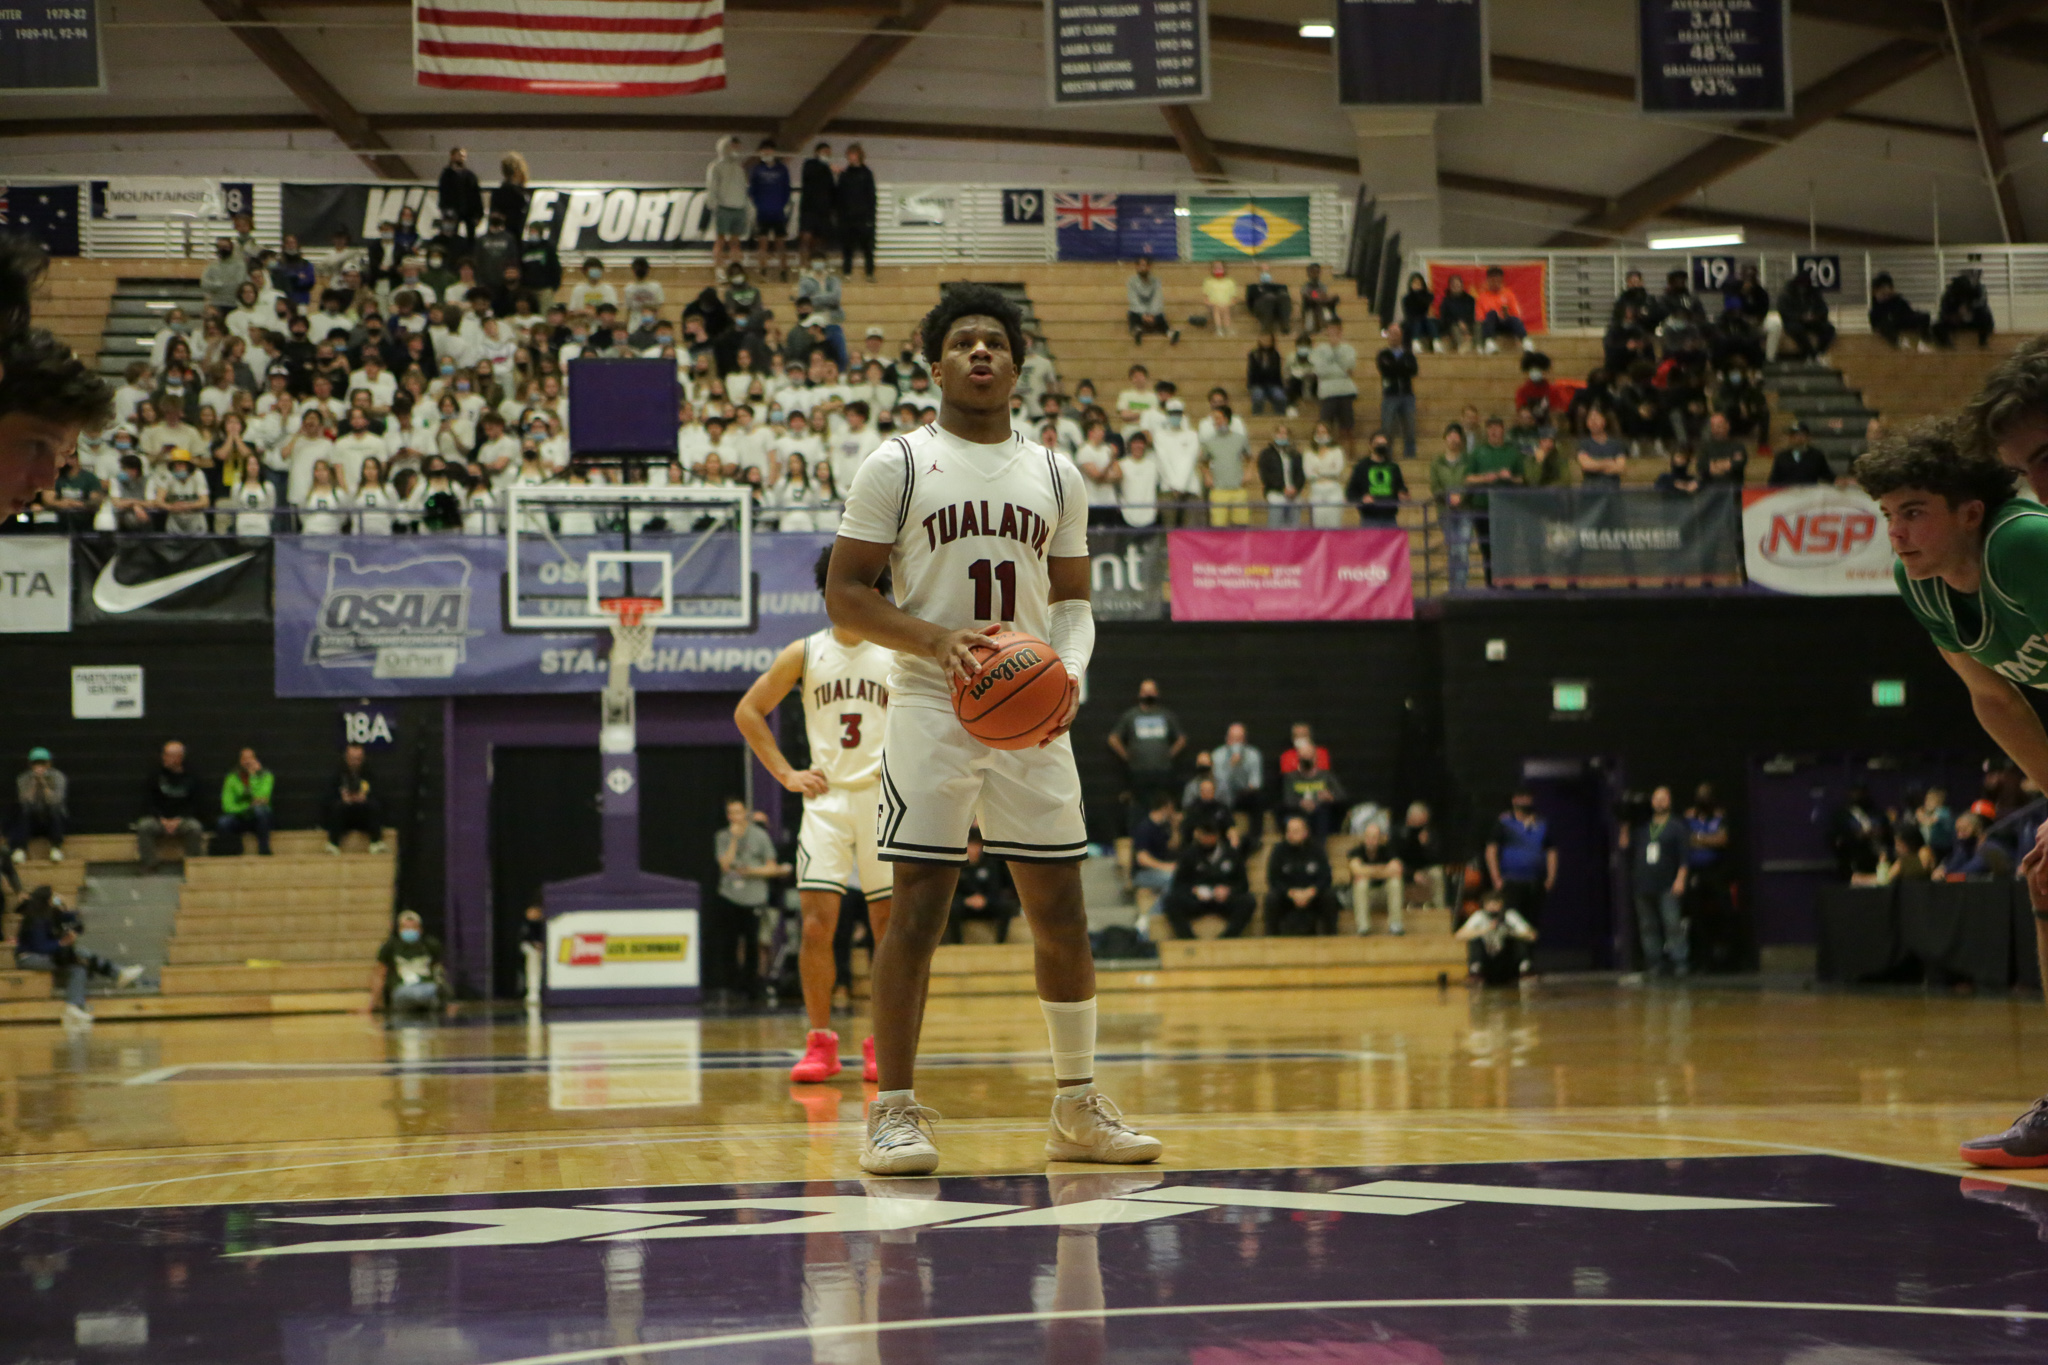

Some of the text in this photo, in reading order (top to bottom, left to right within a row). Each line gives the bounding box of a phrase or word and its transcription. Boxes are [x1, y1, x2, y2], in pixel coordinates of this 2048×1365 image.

[1009, 192, 1038, 221] 19
[1701, 257, 1729, 289] 19
[922, 500, 1050, 561] TUALATIN
[1768, 513, 1877, 556] NSP
[0, 571, 54, 597] TA
[968, 558, 1016, 622] 11
[1338, 565, 1389, 582] moda
[323, 592, 463, 630] OSAA
[968, 647, 1043, 701] Wilson
[343, 711, 393, 744] 18A
[840, 713, 862, 750] 3
